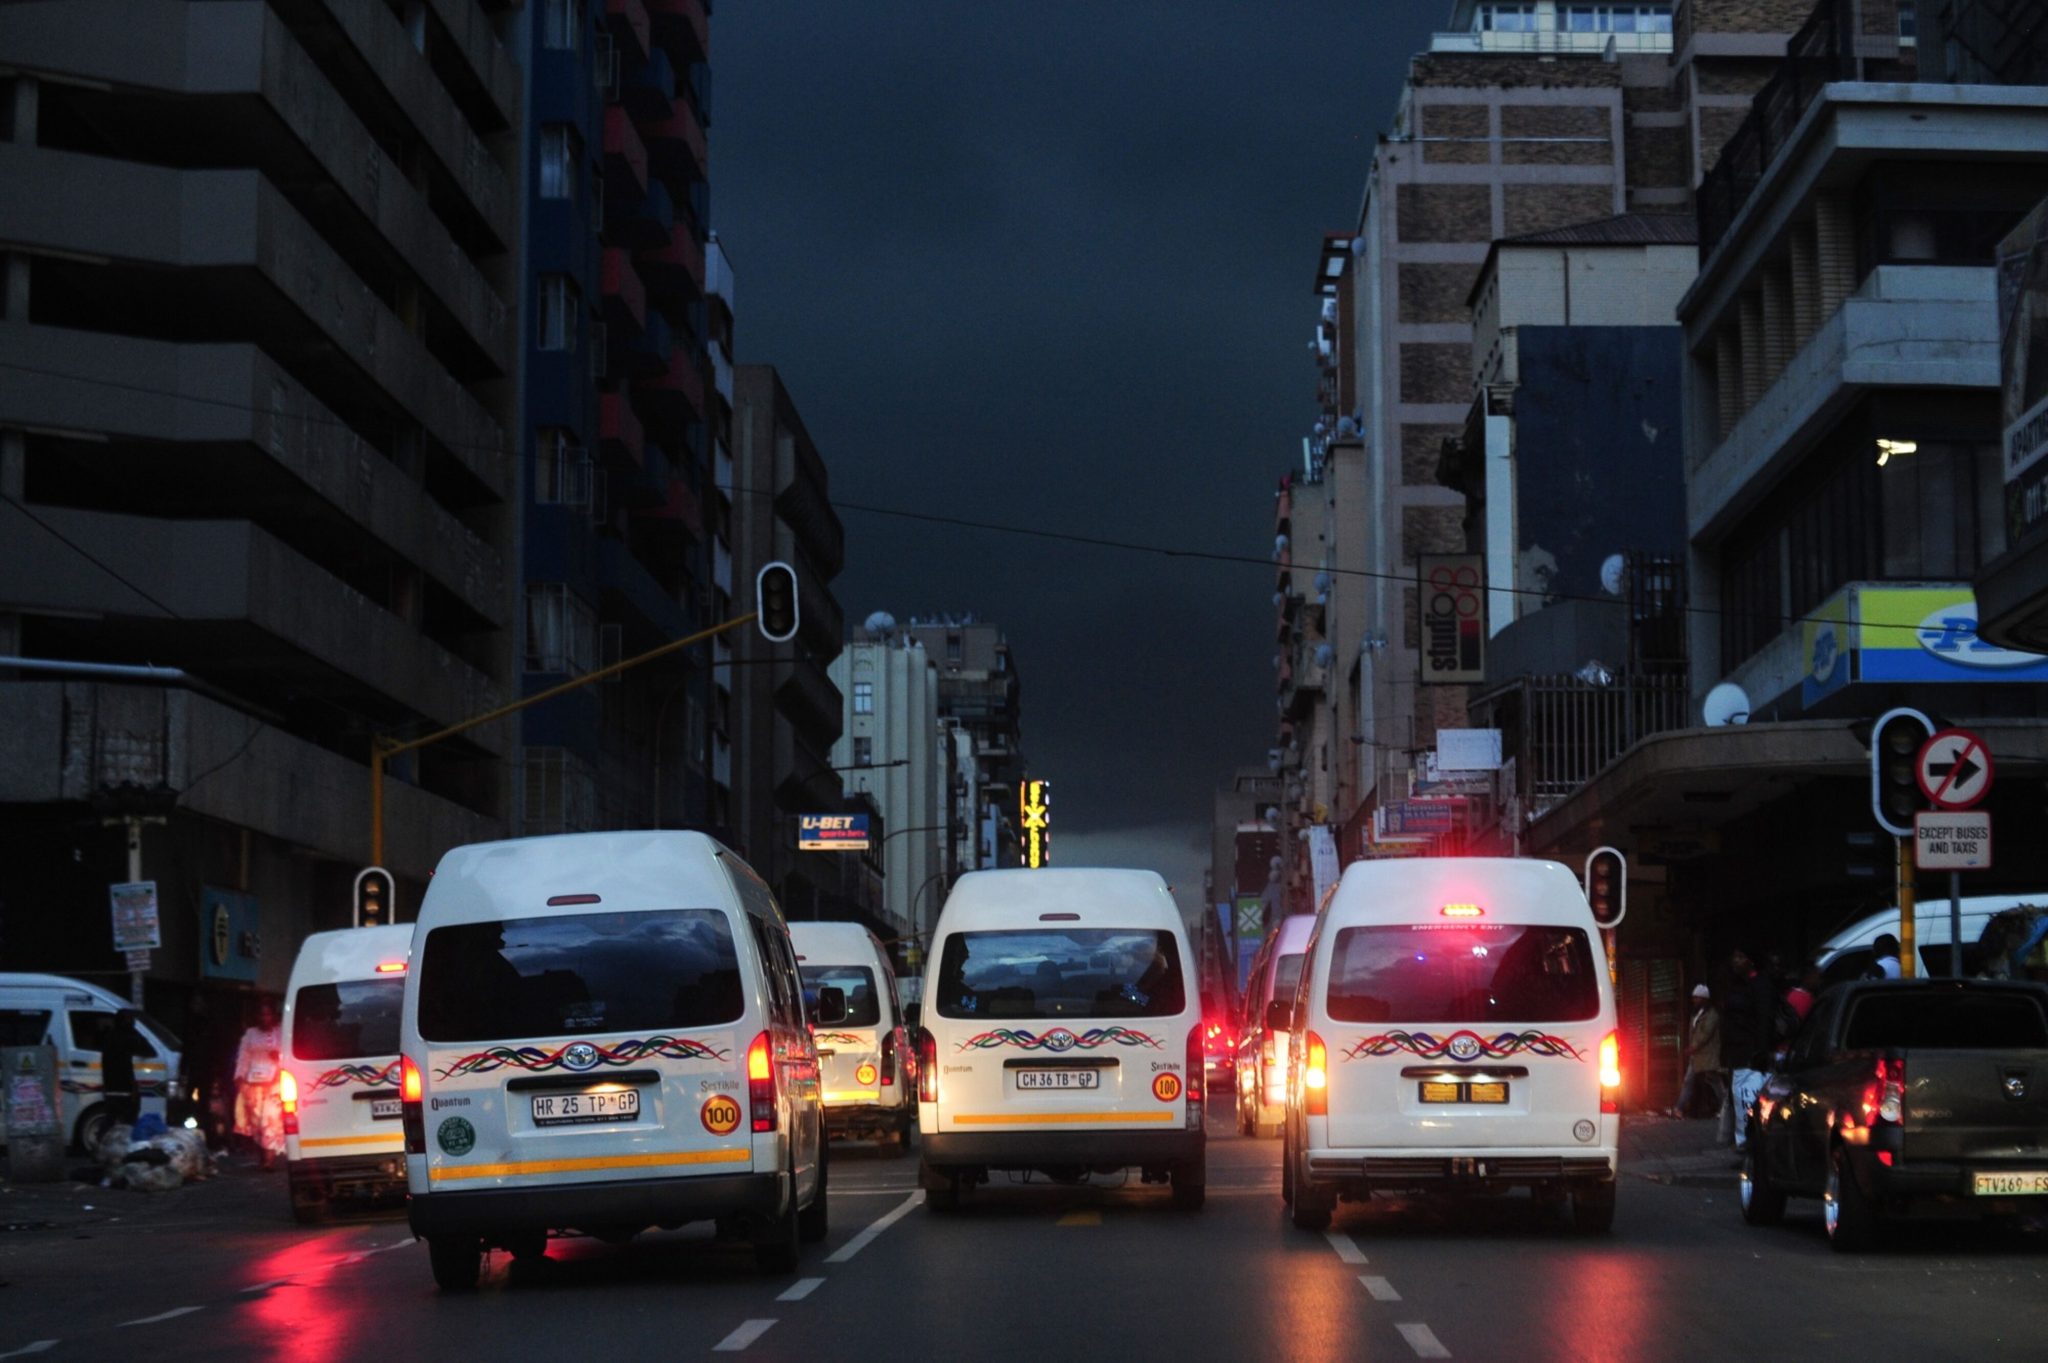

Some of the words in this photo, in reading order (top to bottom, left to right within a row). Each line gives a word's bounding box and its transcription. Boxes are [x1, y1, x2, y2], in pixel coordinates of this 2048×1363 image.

[802, 816, 854, 829] U-BET
[1919, 826, 1955, 839] EXCEPT
[1956, 826, 1989, 839] BUSES
[1929, 842, 1949, 854] AND
[1951, 842, 1978, 854] TAXIS
[1023, 1074, 1037, 1087] CH
[1039, 1074, 1053, 1086] 36
[1056, 1074, 1069, 1086] TB
[1078, 1074, 1092, 1087] GP
[1160, 1079, 1175, 1095] 100
[431, 1097, 471, 1111] Quantum
[536, 1098, 554, 1116] HR
[562, 1097, 579, 1114] 25
[589, 1096, 606, 1112] TP
[618, 1093, 635, 1110] GP
[707, 1106, 736, 1124] 100
[1976, 1177, 2023, 1193] FTV169
